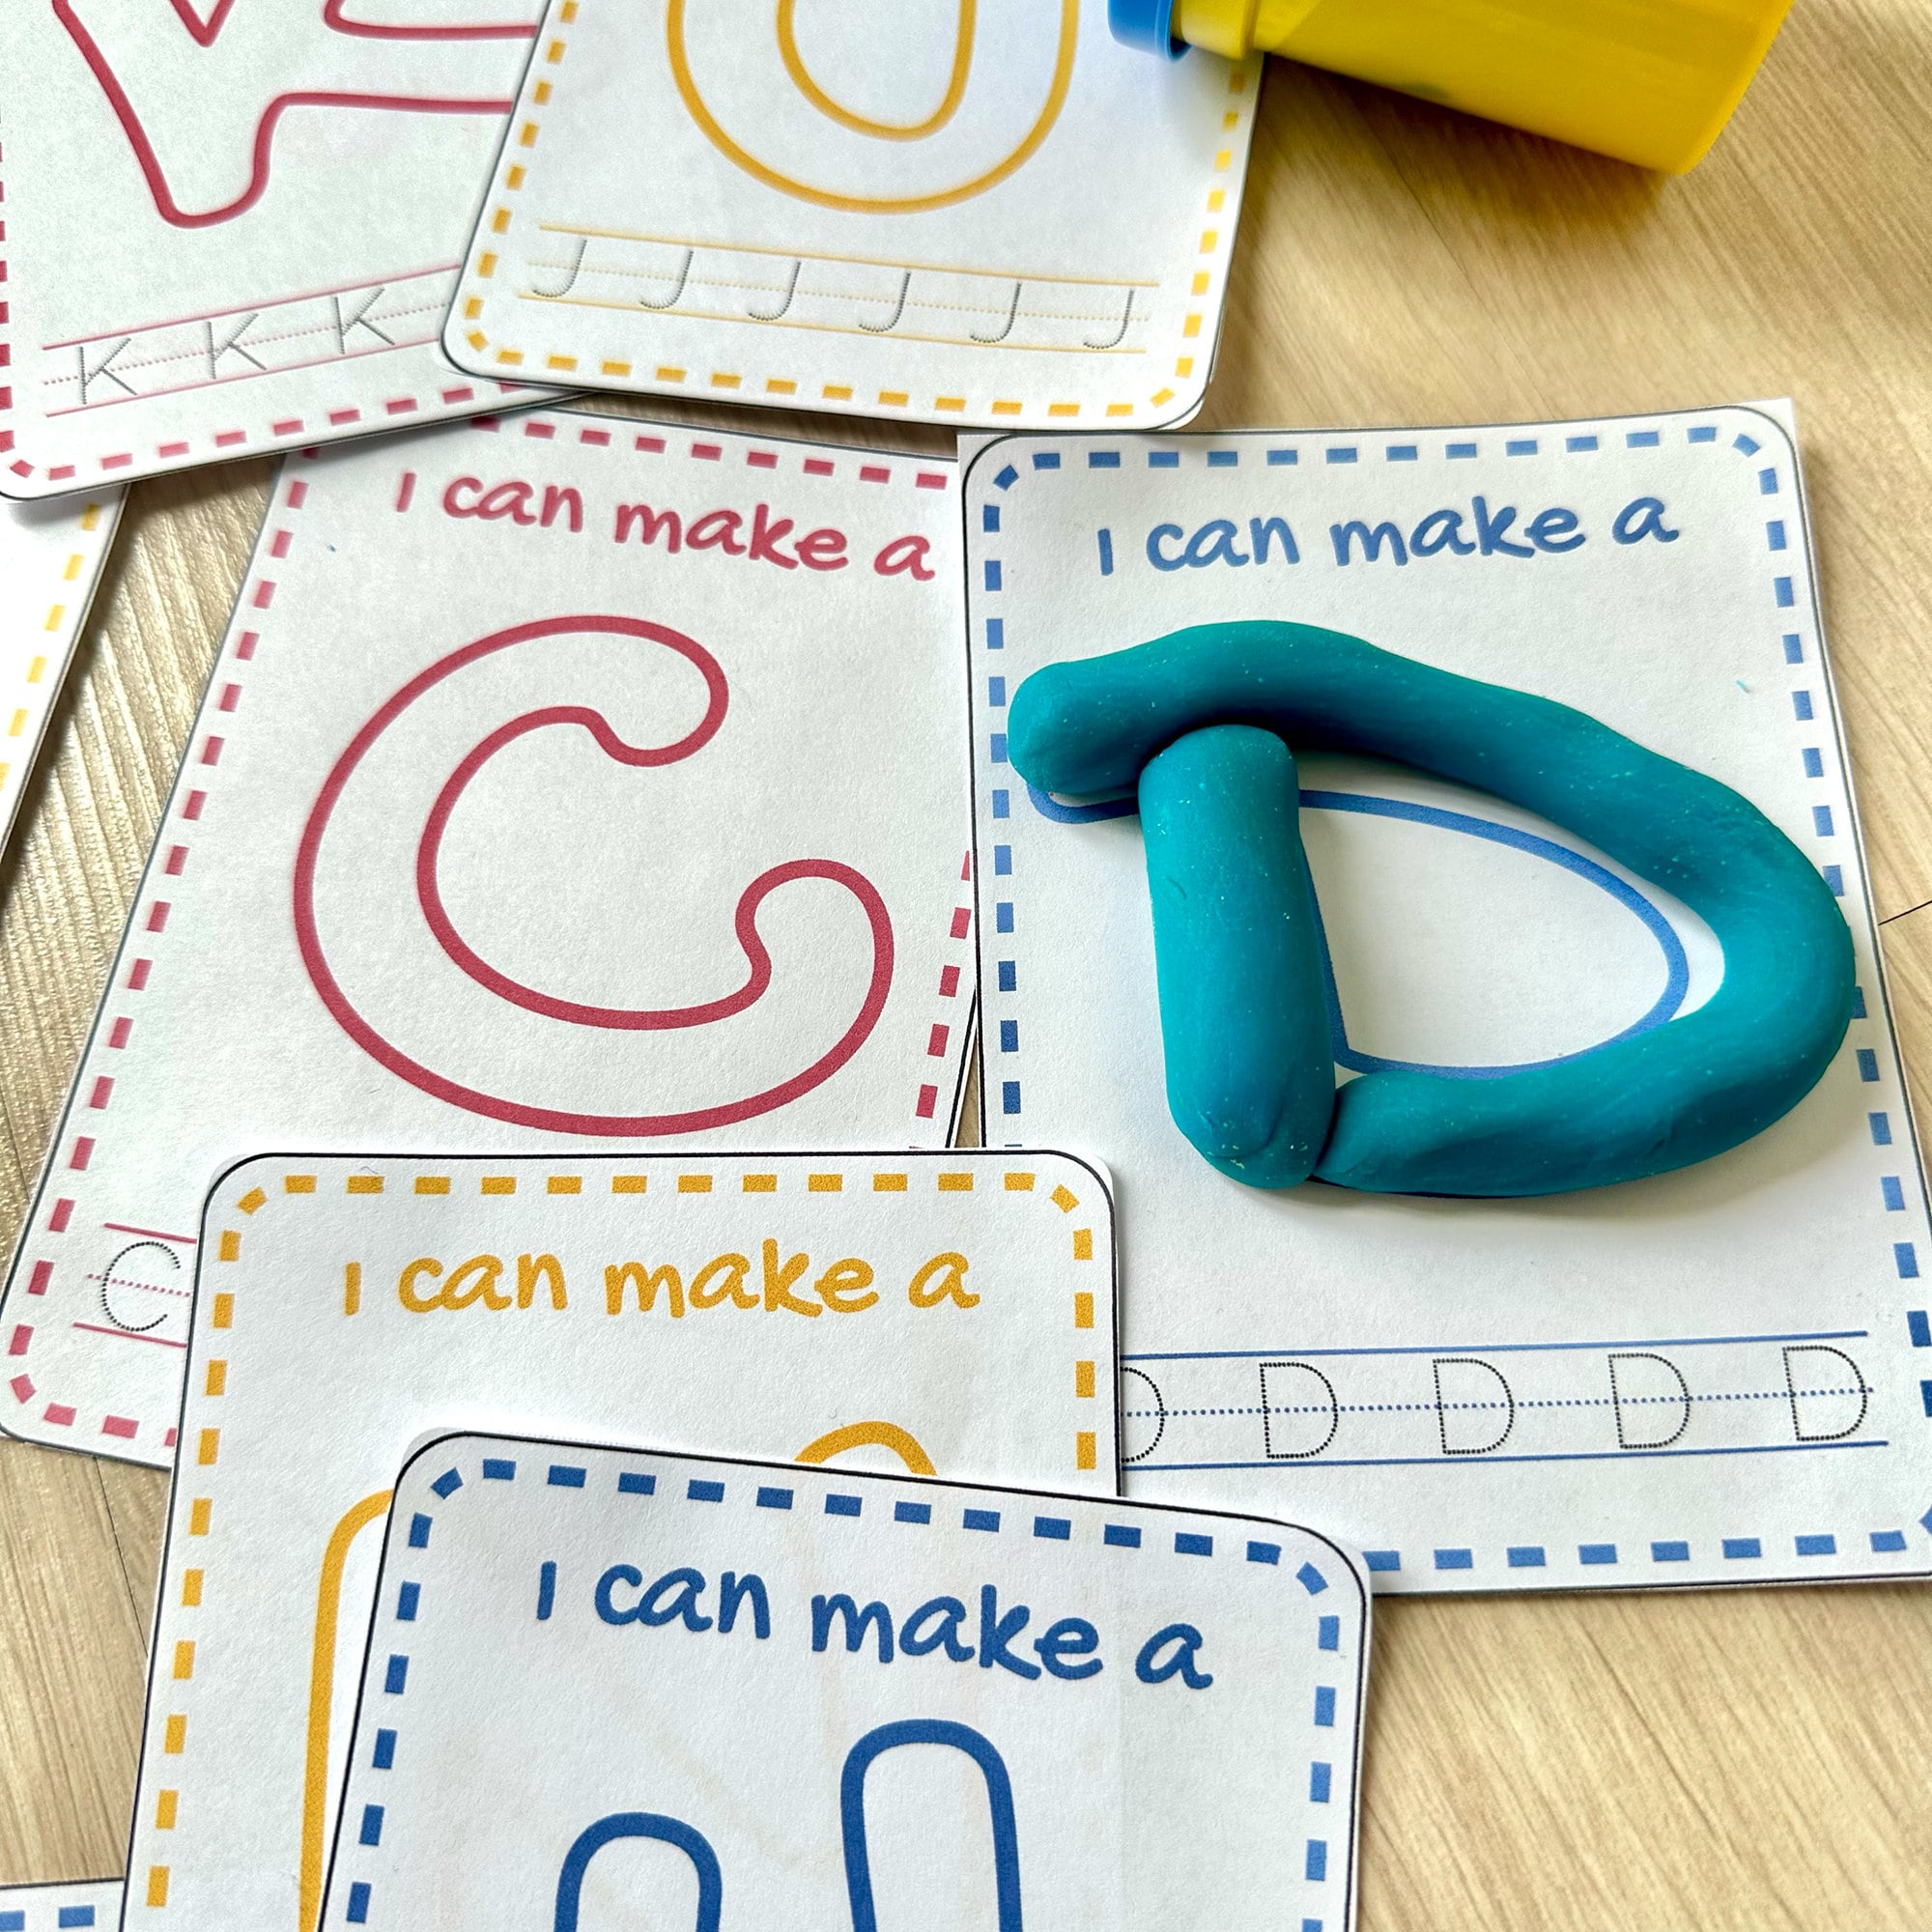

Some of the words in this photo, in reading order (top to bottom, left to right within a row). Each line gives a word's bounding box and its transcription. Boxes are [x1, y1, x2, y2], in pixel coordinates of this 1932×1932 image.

[78, 338, 138, 405] K
[204, 313, 267, 380] K
[330, 288, 396, 355] K
[531, 240, 587, 298] J
[639, 249, 695, 309] J
[747, 261, 803, 321] J
[858, 270, 912, 332] J
[969, 281, 1022, 344] J
[1082, 288, 1135, 349] J
[397, 473, 413, 510] I
[443, 477, 581, 530] can
[615, 504, 847, 570] make
[874, 536, 934, 580] a
[1098, 529, 1113, 575] I
[1147, 518, 1298, 571] can
[1330, 497, 1585, 565] make
[1614, 497, 1679, 544] a
[294, 613, 892, 1135] C
[101, 1241, 182, 1332] C
[344, 1262, 360, 1316] I
[398, 1254, 567, 1313] can
[604, 1238, 879, 1318] make
[908, 1252, 980, 1309] a
[1260, 1362, 1339, 1460] D
[1433, 1357, 1515, 1457] D
[1607, 1352, 1691, 1449] D
[1782, 1346, 1868, 1442] D
[537, 1561, 556, 1620] I
[595, 1564, 770, 1638] can
[811, 1584, 1102, 1680] make
[1135, 1624, 1212, 1690] a
